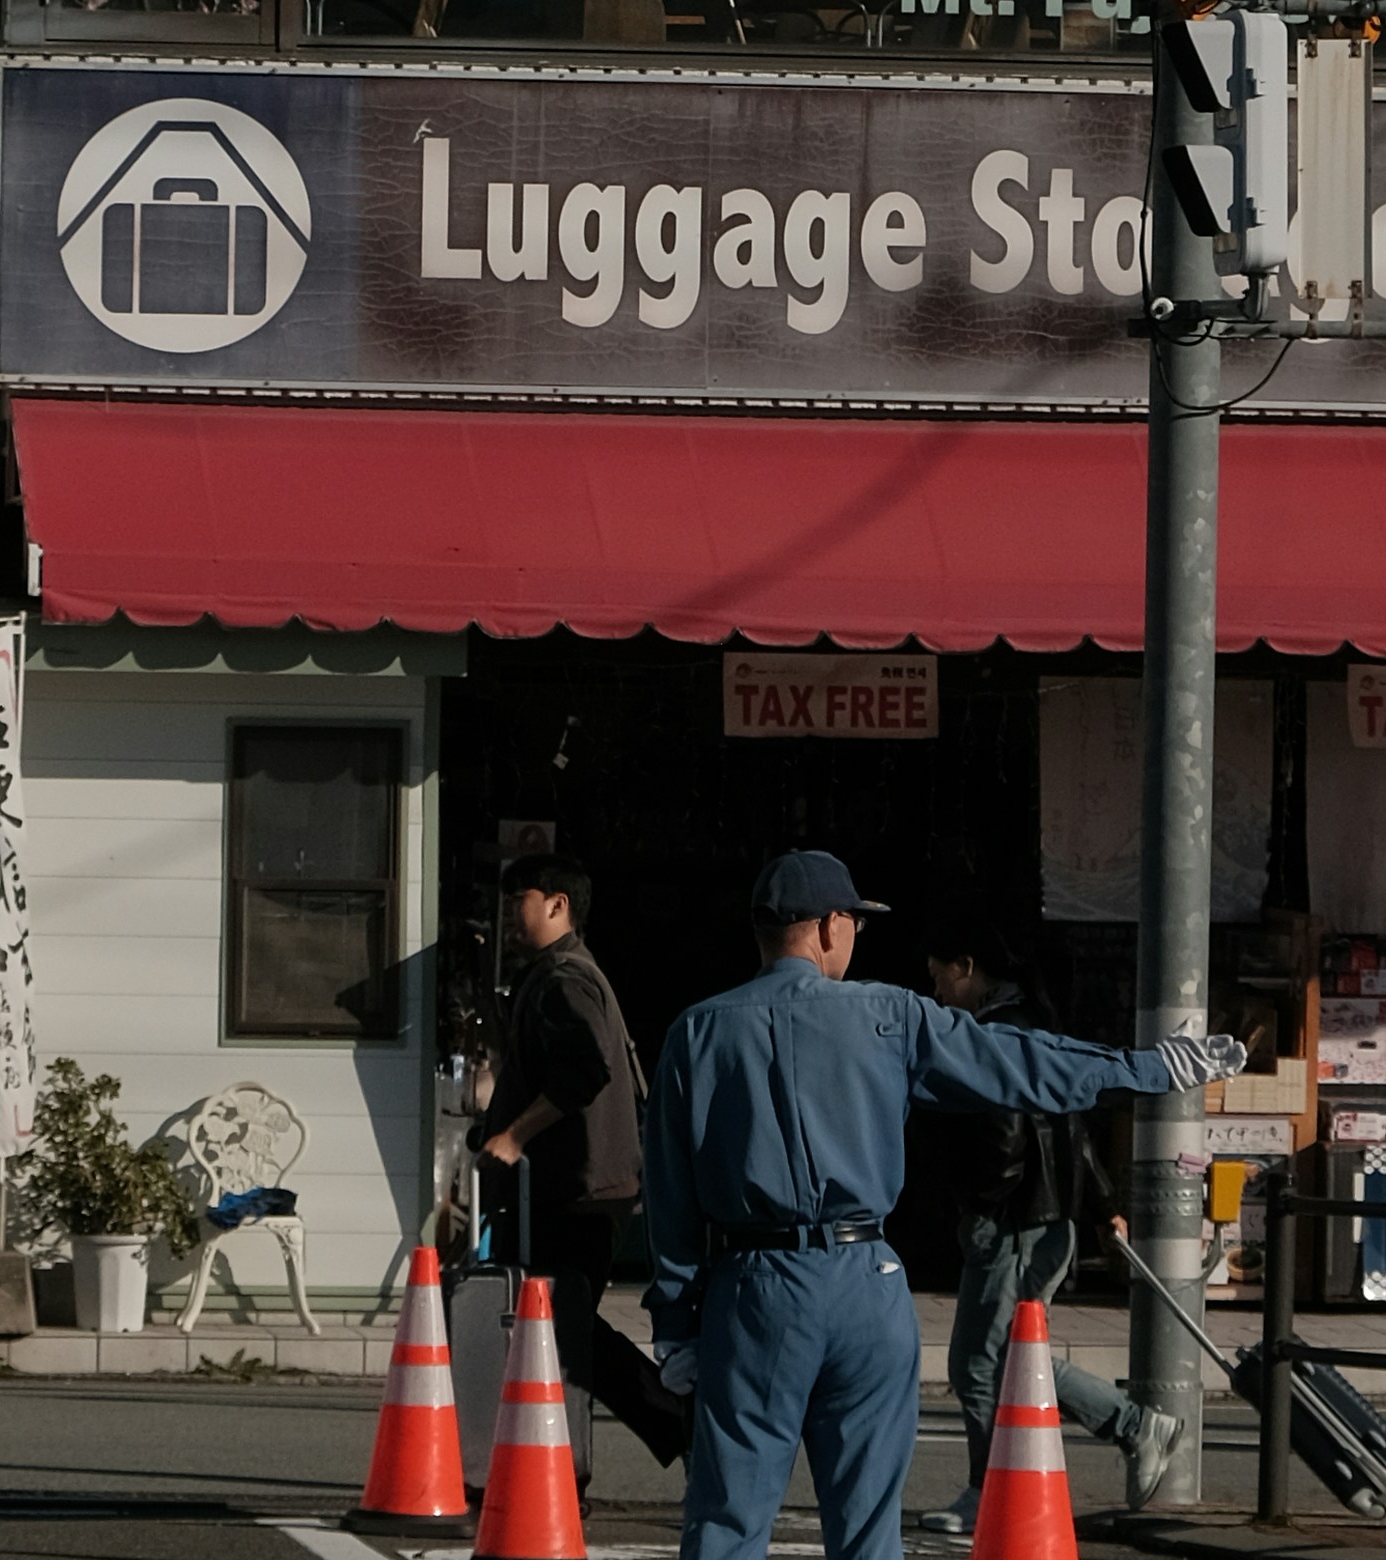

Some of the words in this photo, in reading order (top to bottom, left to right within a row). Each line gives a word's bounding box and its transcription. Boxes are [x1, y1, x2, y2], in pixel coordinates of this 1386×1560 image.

[421, 136, 927, 334] Luggage
[734, 684, 814, 727] TAX
[825, 685, 928, 728] FREE
